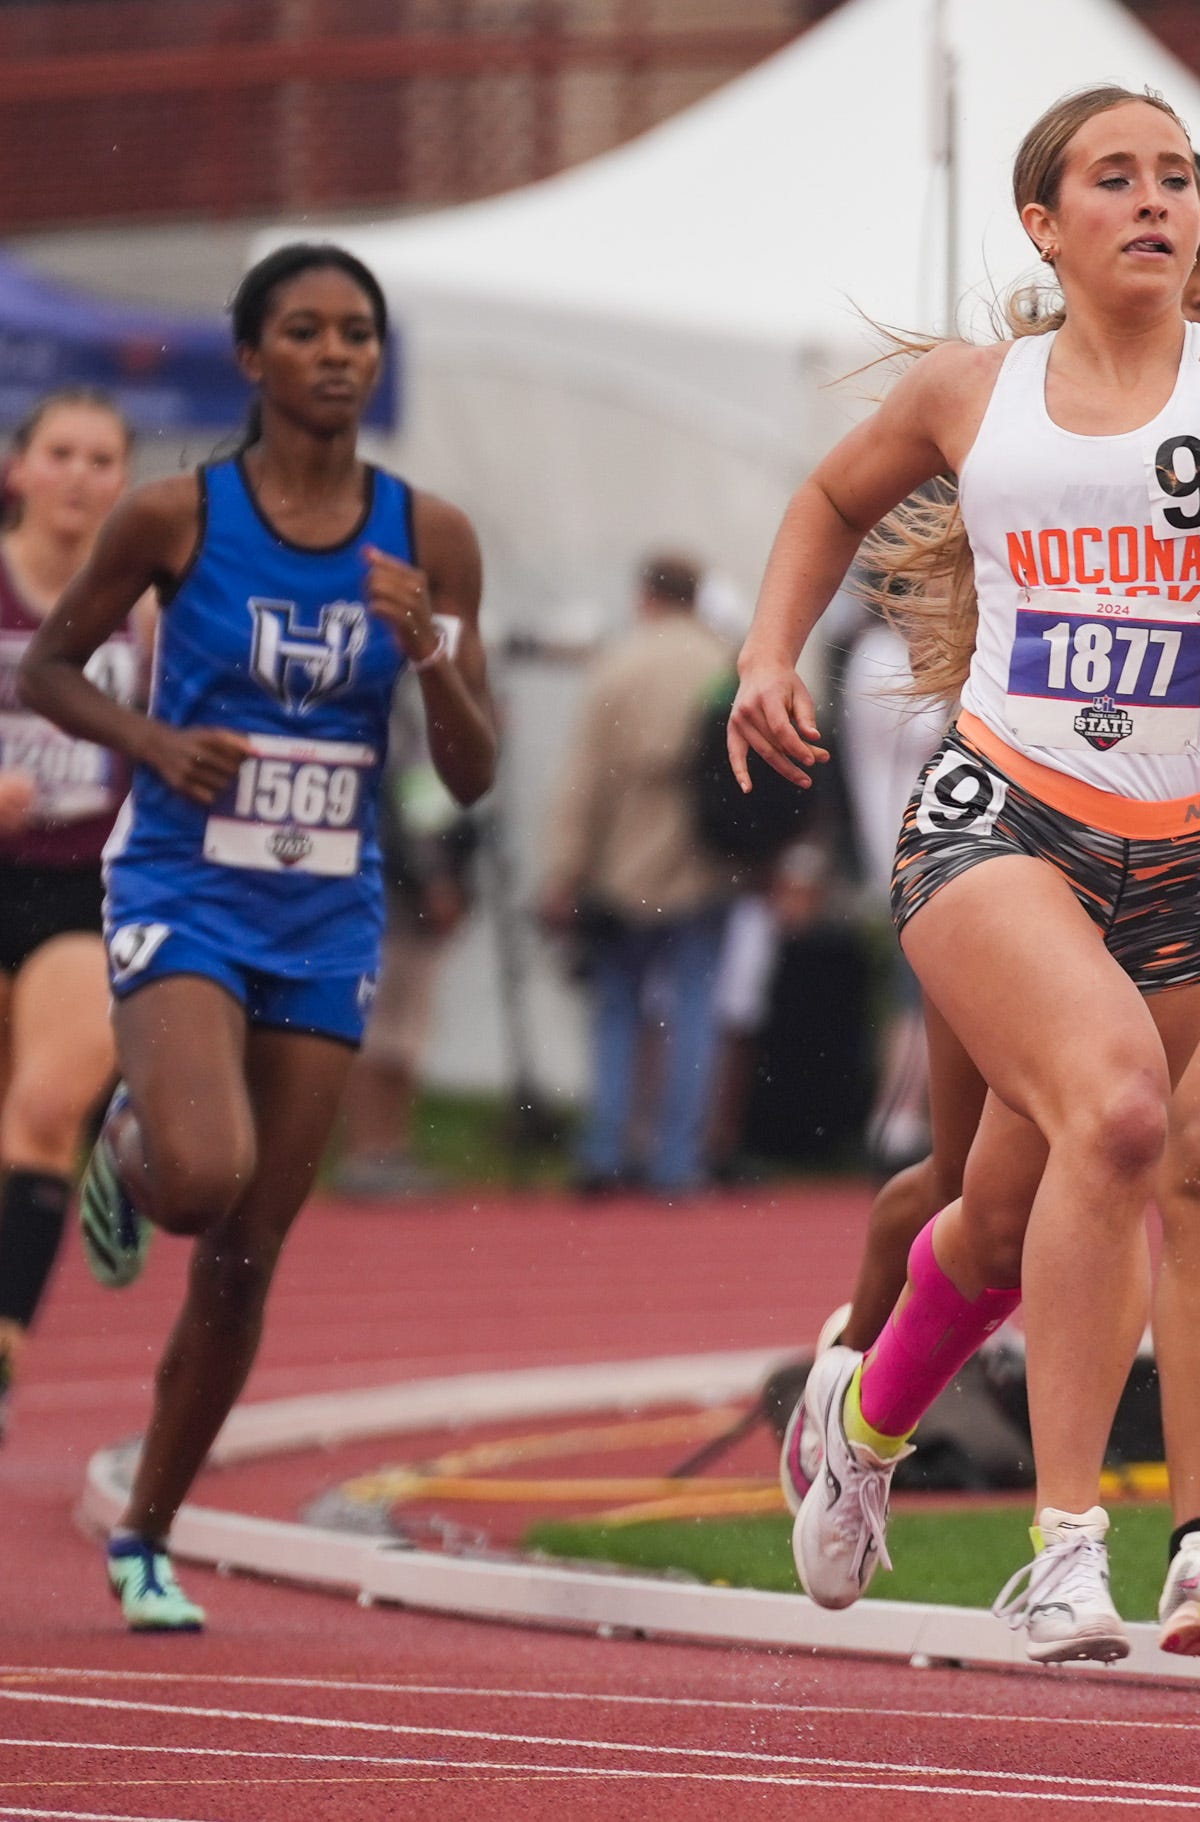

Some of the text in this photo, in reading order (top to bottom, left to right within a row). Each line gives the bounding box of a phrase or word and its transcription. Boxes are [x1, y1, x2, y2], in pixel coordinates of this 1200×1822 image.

[1096, 603, 1131, 615] 2024
[1042, 622, 1183, 697] 1877
[1074, 716, 1133, 734] STATE
[235, 757, 359, 827] 1569
[928, 764, 993, 830] 9
